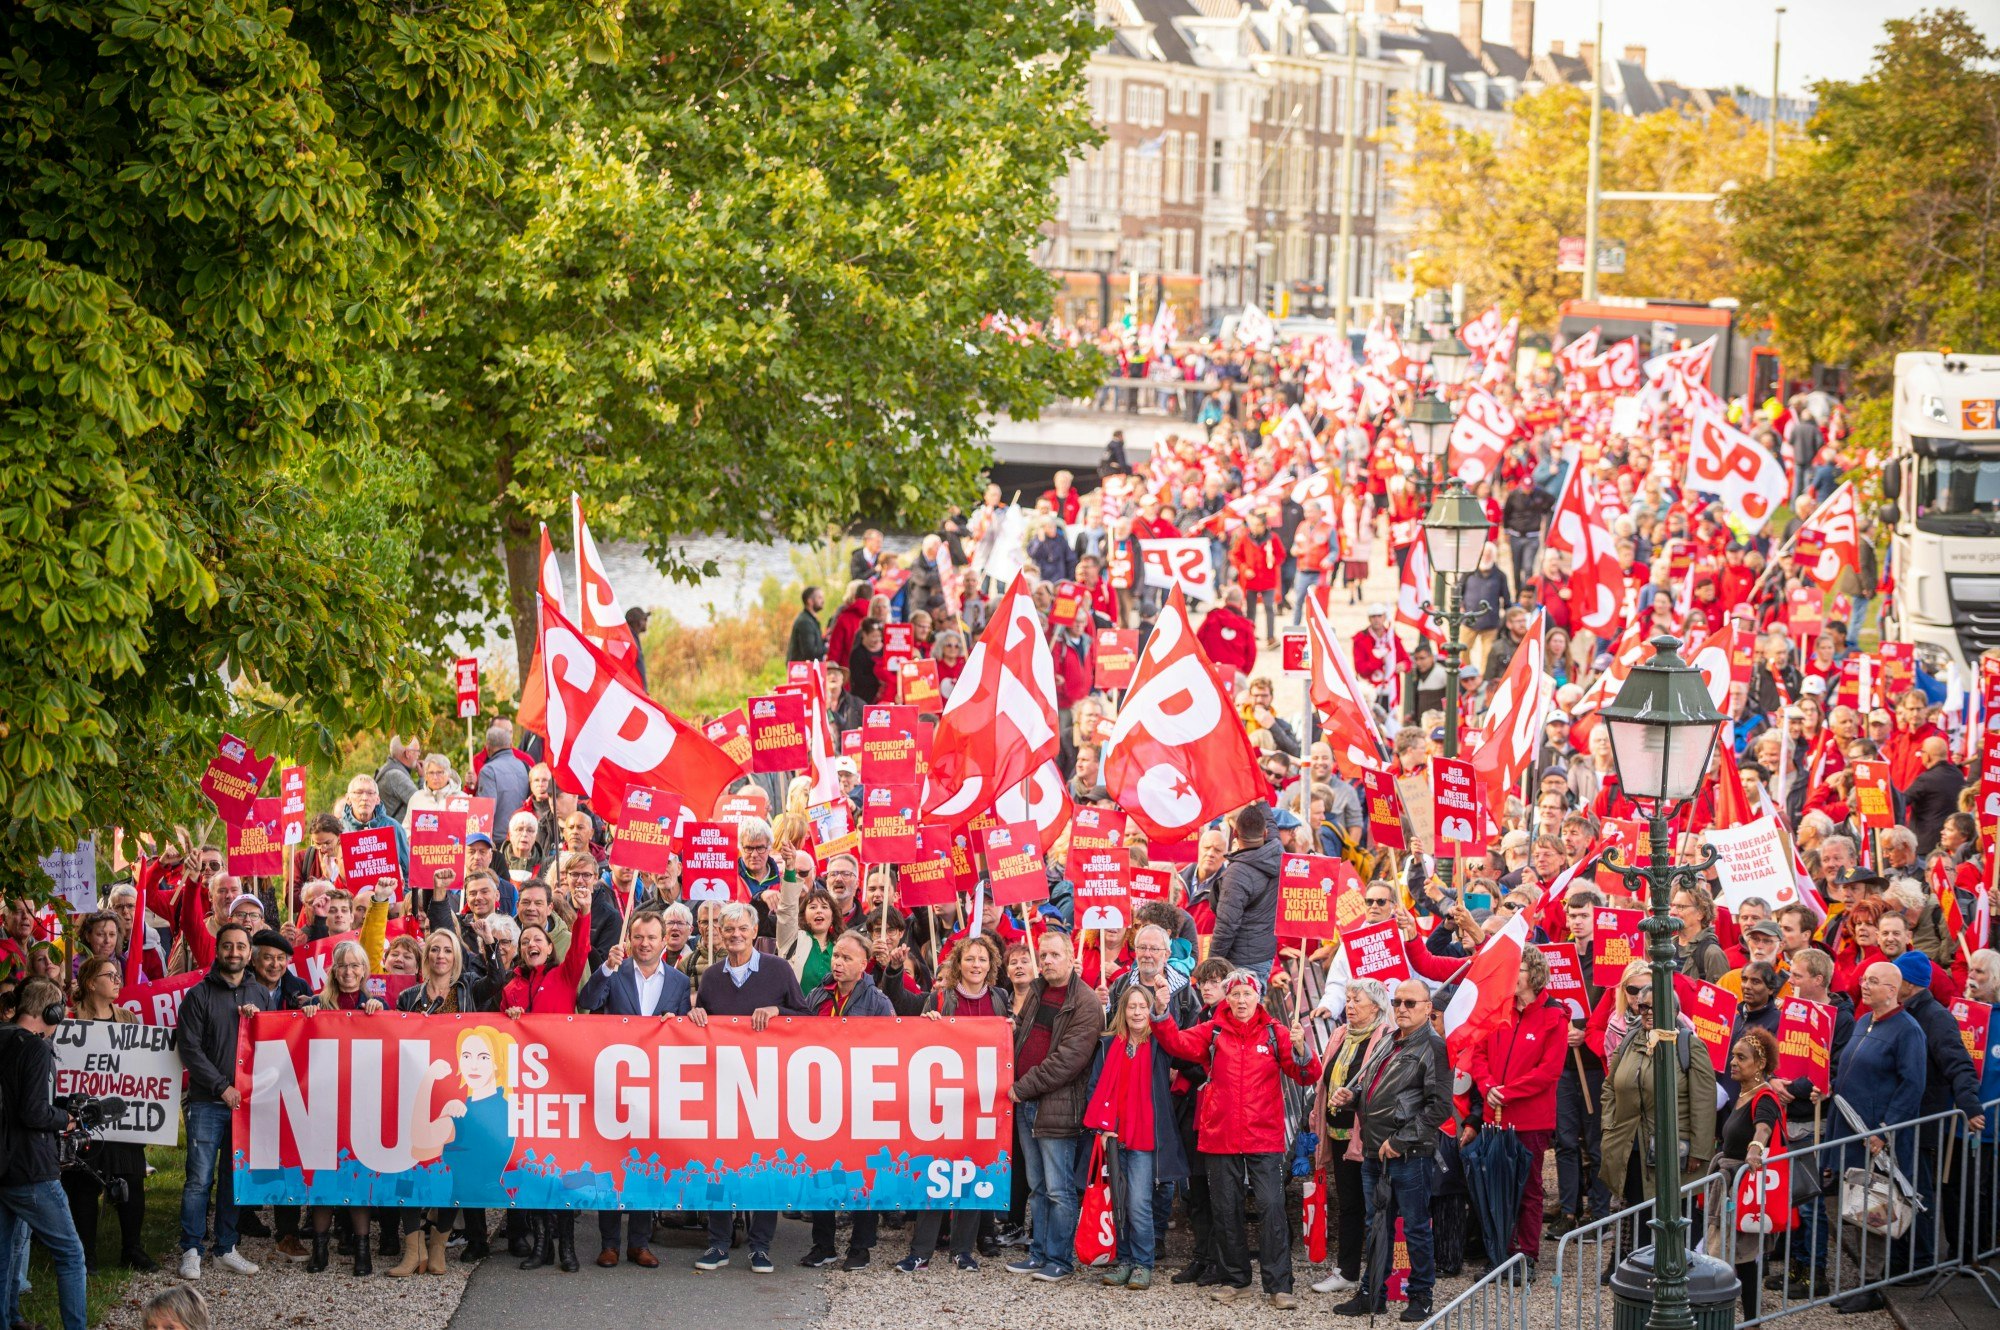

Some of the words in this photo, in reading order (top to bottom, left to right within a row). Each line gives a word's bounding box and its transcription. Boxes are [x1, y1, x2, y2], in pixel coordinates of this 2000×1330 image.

[759, 722, 796, 739] LONEN
[755, 733, 803, 751] OMHOOG
[864, 739, 915, 750] GOEDKOPER
[872, 750, 908, 762] TANKEN
[208, 766, 258, 795] GOEDKOPER
[212, 779, 247, 801] TANKEN
[629, 820, 662, 834] HUREN
[874, 817, 905, 828] HUREN
[242, 827, 266, 838] EIGEN
[617, 829, 671, 846] BEVRIEZEN
[701, 829, 720, 837] GOED
[864, 826, 915, 838] BEVRIEZEN
[240, 836, 268, 847] RISICO
[358, 836, 378, 846] GOED
[692, 836, 729, 845] PENSIOEN
[1716, 831, 1777, 853] EO-LIBERAAL
[230, 842, 281, 857] AFSCHAFFEN
[351, 842, 387, 855] PENSIOEN
[412, 844, 463, 856] GOEDKOPER
[1735, 844, 1773, 861] MAATJE
[421, 854, 456, 865] TANKEN
[694, 852, 727, 861] KWESTIE
[998, 854, 1031, 869] HUREN
[1091, 855, 1111, 864] GOED
[349, 868, 364, 878] VAN
[365, 864, 396, 876] FATSOEN
[355, 858, 387, 870] KWESTIE
[686, 860, 701, 869] VAN
[703, 860, 734, 869] FATSOEN
[901, 857, 951, 875] GOEDKOPER
[991, 860, 1042, 881] BEVRIEZEN
[1082, 863, 1120, 872] PENSIOEN
[1731, 862, 1751, 872] VAN
[1753, 856, 1770, 868] HET
[910, 870, 945, 884] TANKEN
[1136, 874, 1154, 885] GOED
[1731, 866, 1777, 882] KAPITAAL
[1085, 879, 1118, 888] KWESTIE
[1078, 887, 1093, 896] VAN
[1094, 887, 1127, 896] FATSOEN
[1282, 887, 1331, 899] ENERGIE-
[1286, 899, 1328, 911] KOSTEN
[1284, 910, 1328, 921] OMLAAG
[1350, 928, 1394, 950] INDEXATIE
[1362, 940, 1386, 956] VOOR
[1605, 947, 1631, 956] RISICO
[1361, 949, 1392, 965] IEDERE
[1595, 955, 1643, 965] AFSCHAFFEN
[1356, 955, 1401, 977] GENERATIE
[1553, 981, 1581, 989] FATSOEN
[56, 1020, 94, 1047] IJ
[107, 1023, 177, 1051] WILLEN
[1695, 1029, 1722, 1045] TANKEN
[1779, 1041, 1810, 1057] OMHO
[84, 1054, 120, 1073] EEN
[508, 1044, 549, 1088] IS
[56, 1069, 172, 1100] ETROUWBARE
[594, 1044, 998, 1142] GENOEG!
[250, 1039, 430, 1173] NU
[508, 1093, 586, 1139] HET
